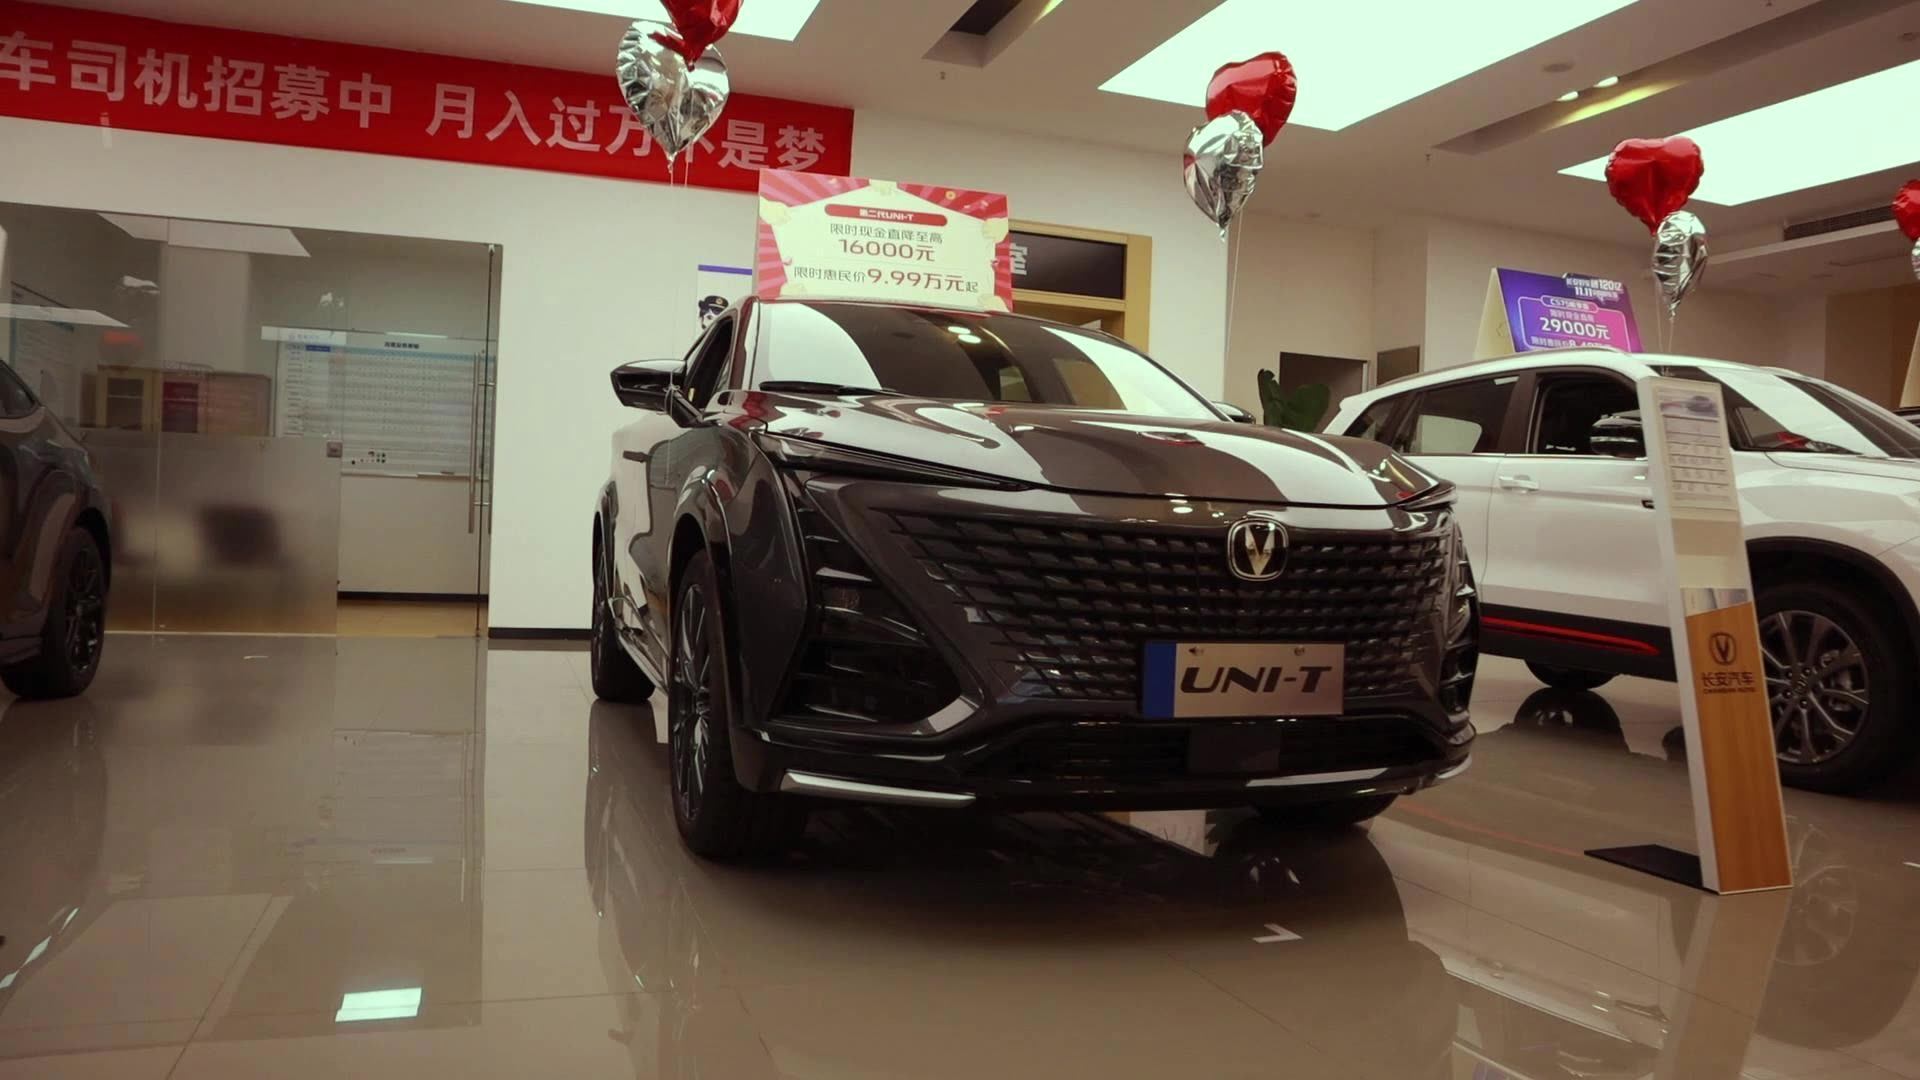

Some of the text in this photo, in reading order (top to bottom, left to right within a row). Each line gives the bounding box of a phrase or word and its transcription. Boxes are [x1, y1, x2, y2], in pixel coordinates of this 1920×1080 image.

[426, 83, 826, 172] 月入过万是梦
[830, 223, 943, 244] 限时现金直降至高
[838, 239, 935, 262] 16000元
[794, 266, 979, 293] 限时惠民价9.99万元起
[1540, 318, 1611, 339] 29000元
[1180, 666, 1332, 693] UNI-T
